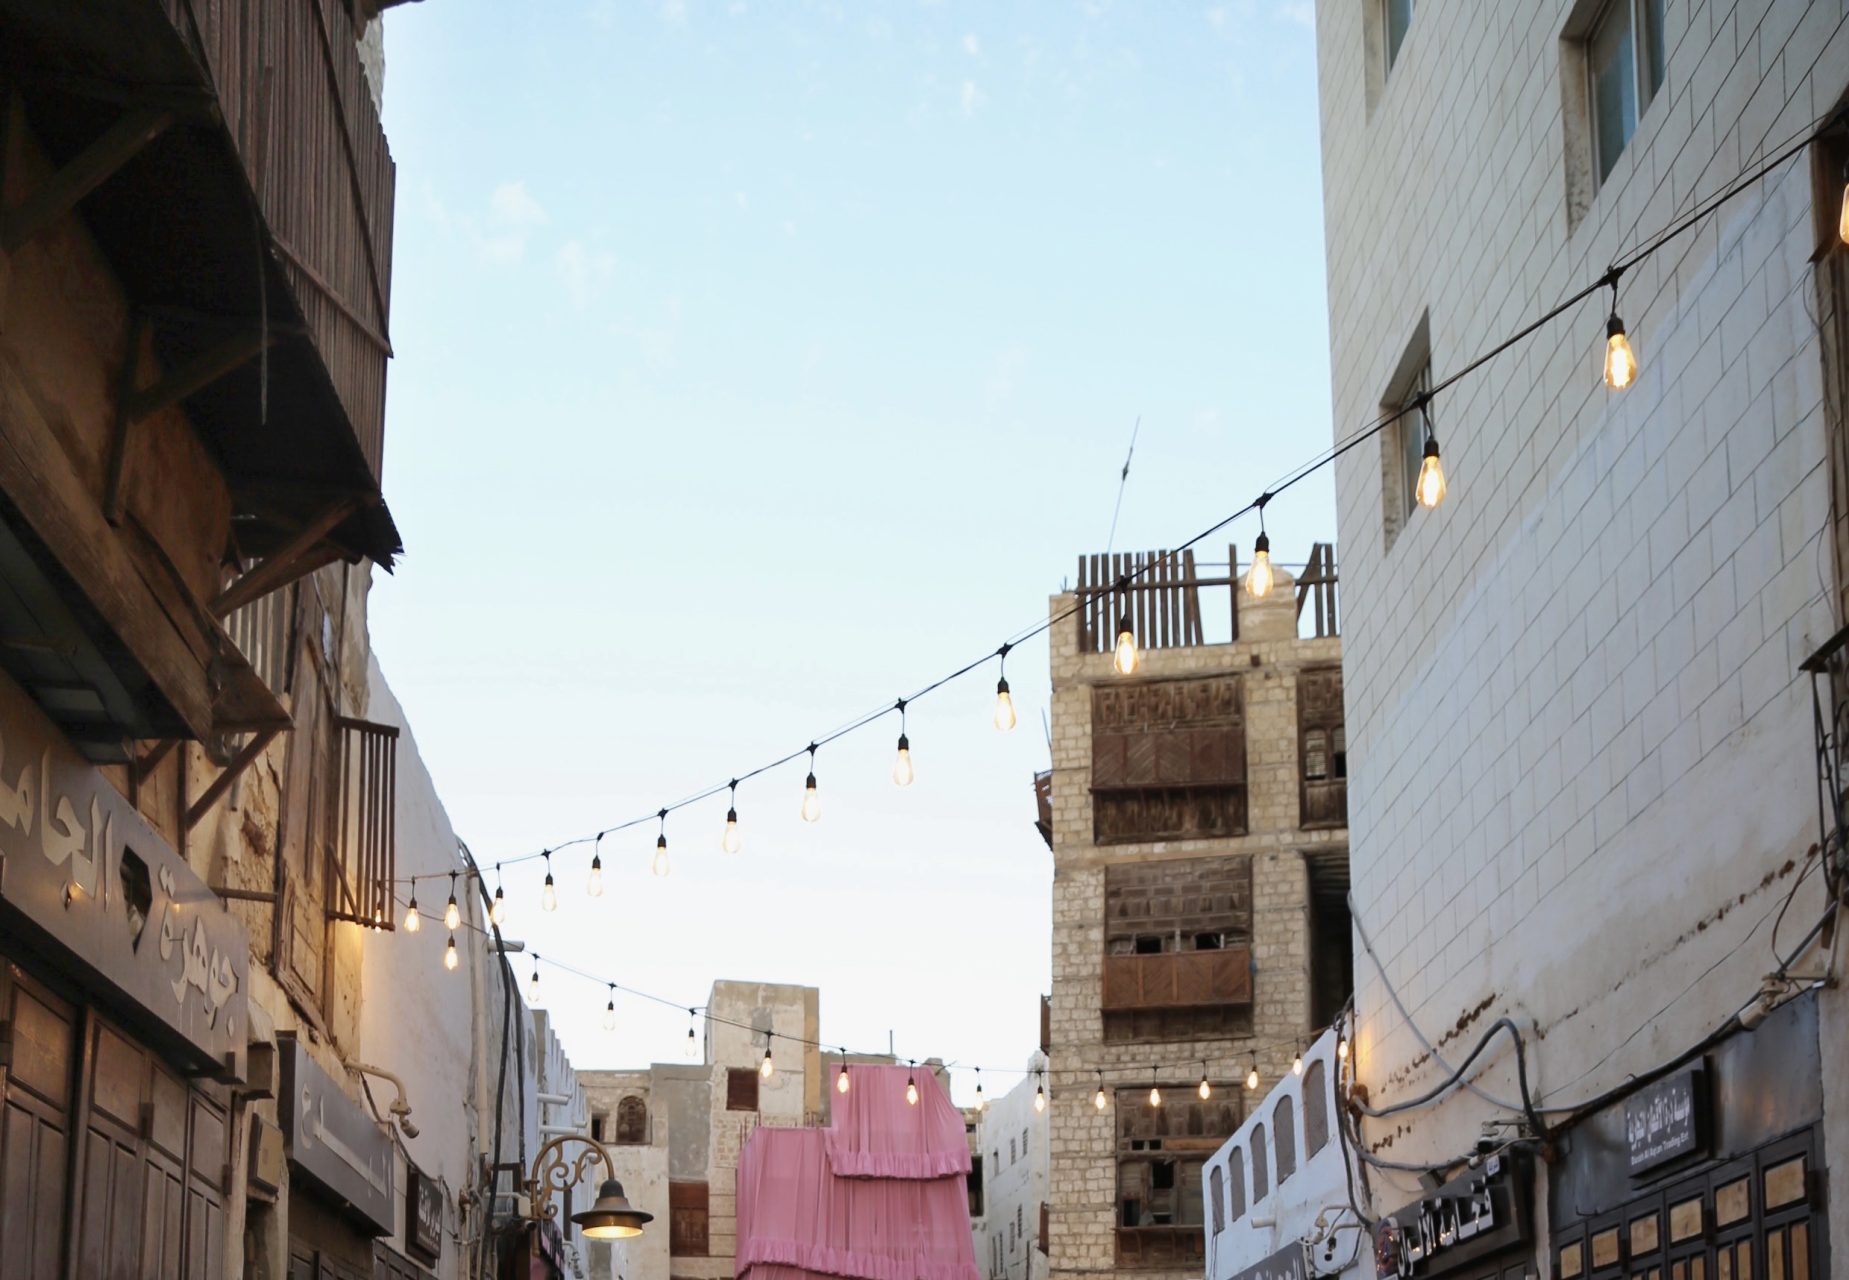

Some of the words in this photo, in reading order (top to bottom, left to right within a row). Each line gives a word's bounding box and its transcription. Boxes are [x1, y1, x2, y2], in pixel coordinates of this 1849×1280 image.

[0, 750, 113, 913] الجام
[158, 863, 239, 1038] جوهرة
[1662, 1136, 1681, 1151] Trading
[1397, 1196, 1437, 1277] الألوان
[1435, 1174, 1494, 1246] فخامة
